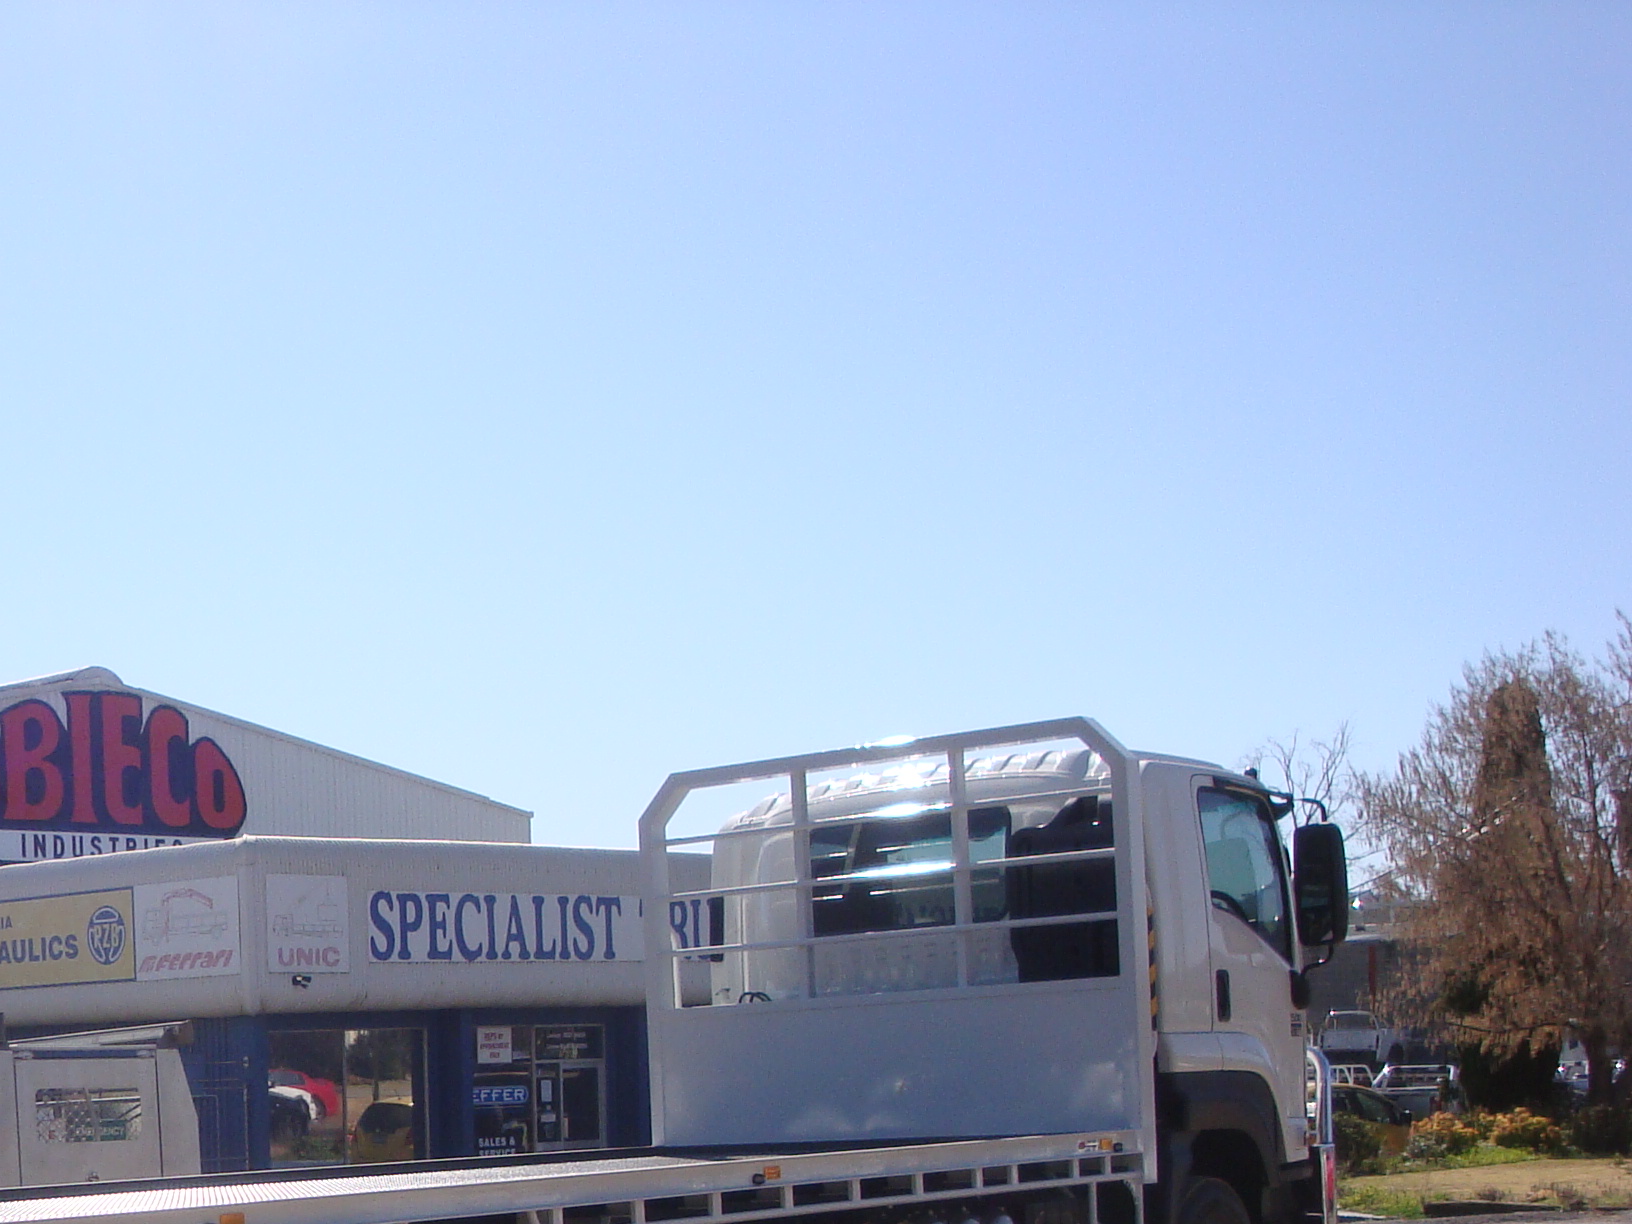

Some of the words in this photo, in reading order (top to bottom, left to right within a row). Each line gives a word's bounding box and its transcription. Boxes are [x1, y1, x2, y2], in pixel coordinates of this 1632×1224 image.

[370, 890, 622, 962] SPECIALIST
[277, 946, 341, 968] UNIC
[478, 1137, 507, 1148] SALES
